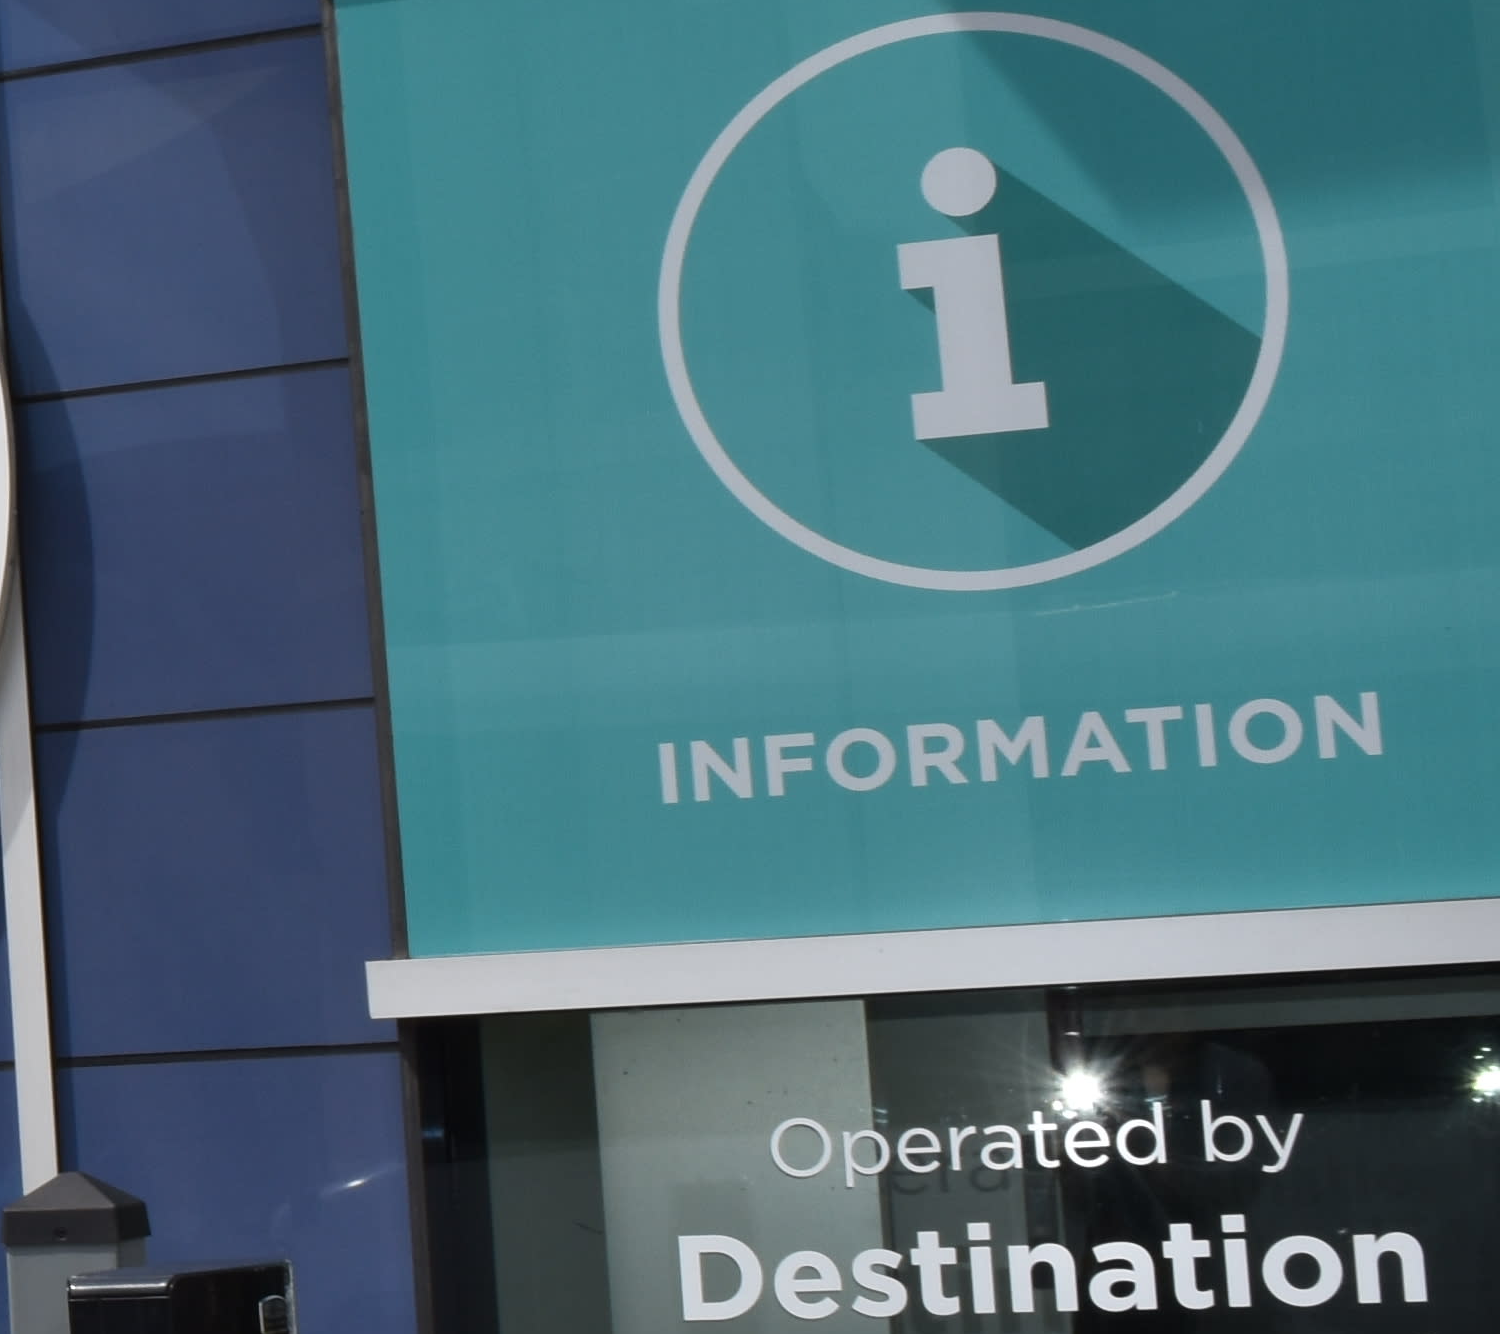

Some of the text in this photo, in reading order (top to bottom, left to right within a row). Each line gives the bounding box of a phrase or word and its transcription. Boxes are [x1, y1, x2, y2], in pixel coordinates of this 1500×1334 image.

[657, 690, 1384, 804] INFORMATION
[769, 1099, 1305, 1187] Operated by
[678, 1214, 1428, 1322] Destination
